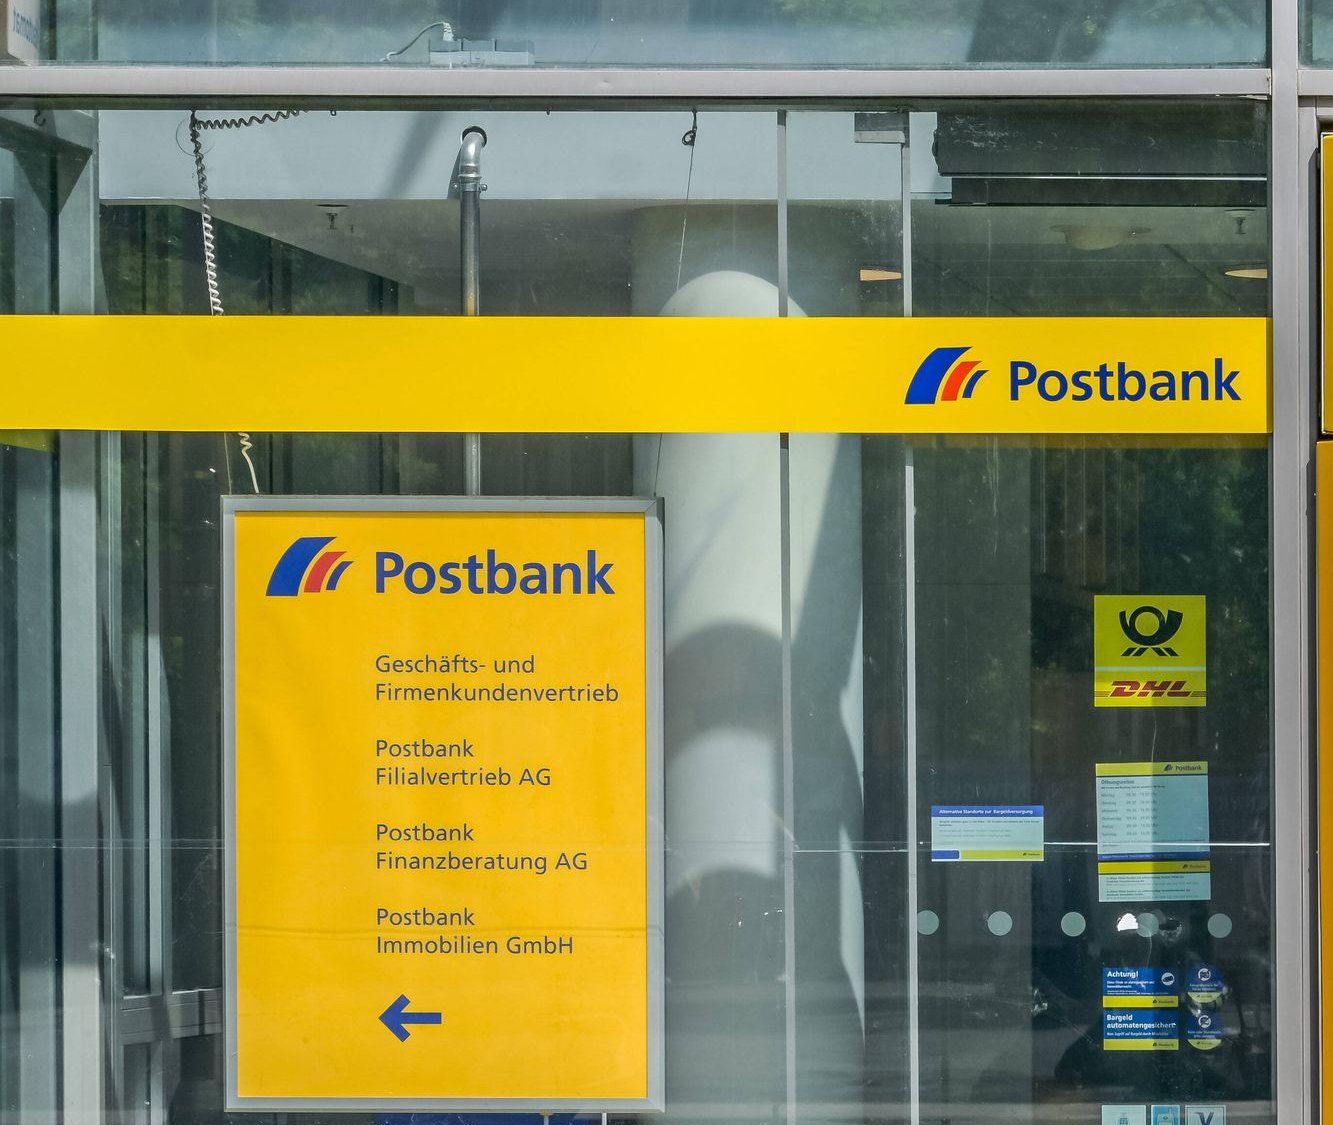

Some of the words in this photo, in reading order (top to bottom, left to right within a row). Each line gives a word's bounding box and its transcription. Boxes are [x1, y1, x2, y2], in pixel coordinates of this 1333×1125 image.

[1010, 358, 1240, 402] Postbank
[375, 549, 616, 595] Postbank
[376, 654, 485, 674] Geschäfts-
[494, 654, 535, 674] und
[376, 682, 619, 703] Firmenkundenvertrieb
[1110, 681, 1192, 697] DHL
[376, 738, 474, 758] Postbank
[376, 766, 512, 786] Filialvertrieb
[519, 767, 552, 786] AG
[376, 822, 474, 842] Postbank
[376, 850, 547, 875] Finanzberatung
[556, 852, 588, 871] AG
[377, 907, 475, 926] Postbank
[377, 935, 499, 955] Immobilien
[506, 935, 573, 955] GmbH
